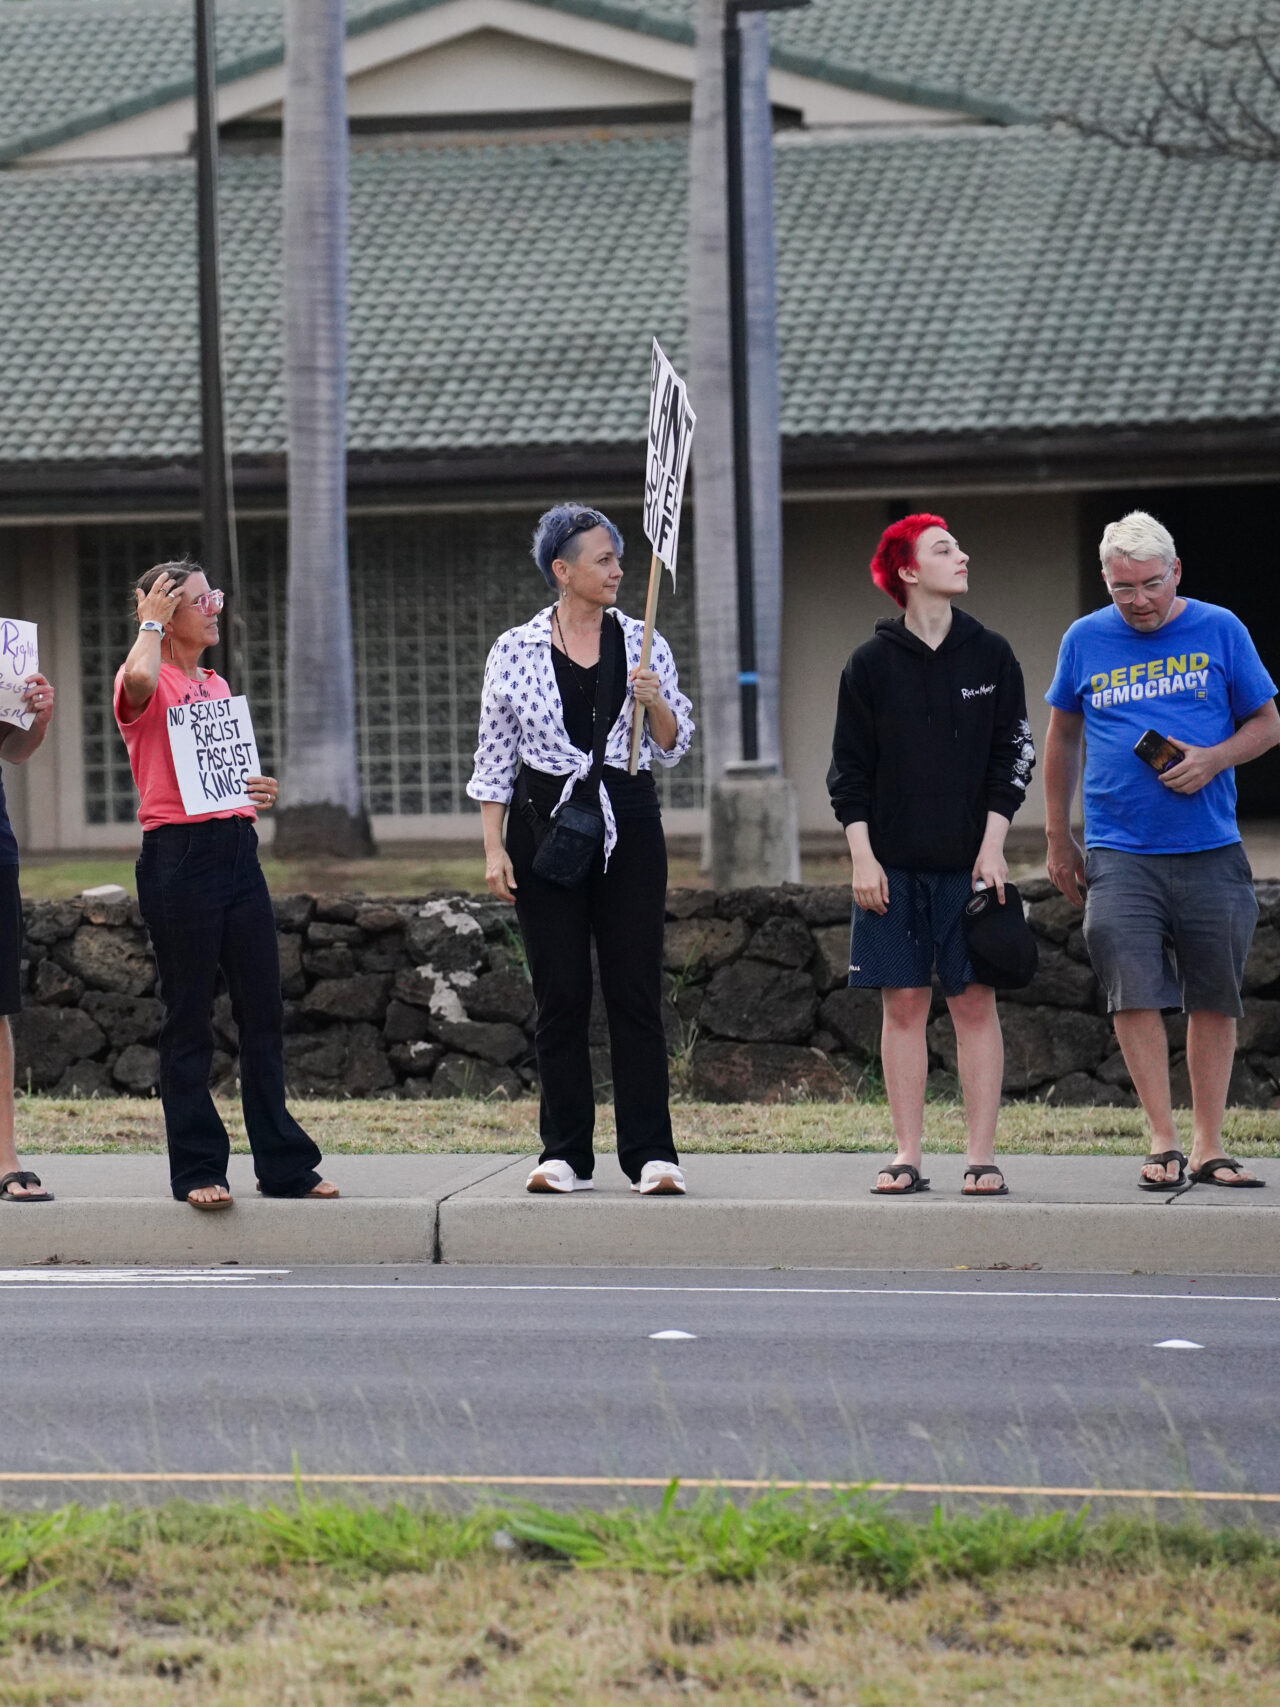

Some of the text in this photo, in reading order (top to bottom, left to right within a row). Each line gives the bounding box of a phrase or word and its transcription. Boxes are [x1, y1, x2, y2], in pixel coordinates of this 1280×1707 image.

[1090, 652, 1209, 693] DEFEND
[1091, 669, 1209, 710] DEMOCRACY
[168, 699, 231, 727] NO SEXIST
[190, 718, 241, 748] RACIST
[196, 742, 252, 772] FASCIST
[198, 766, 251, 802] KINGS
